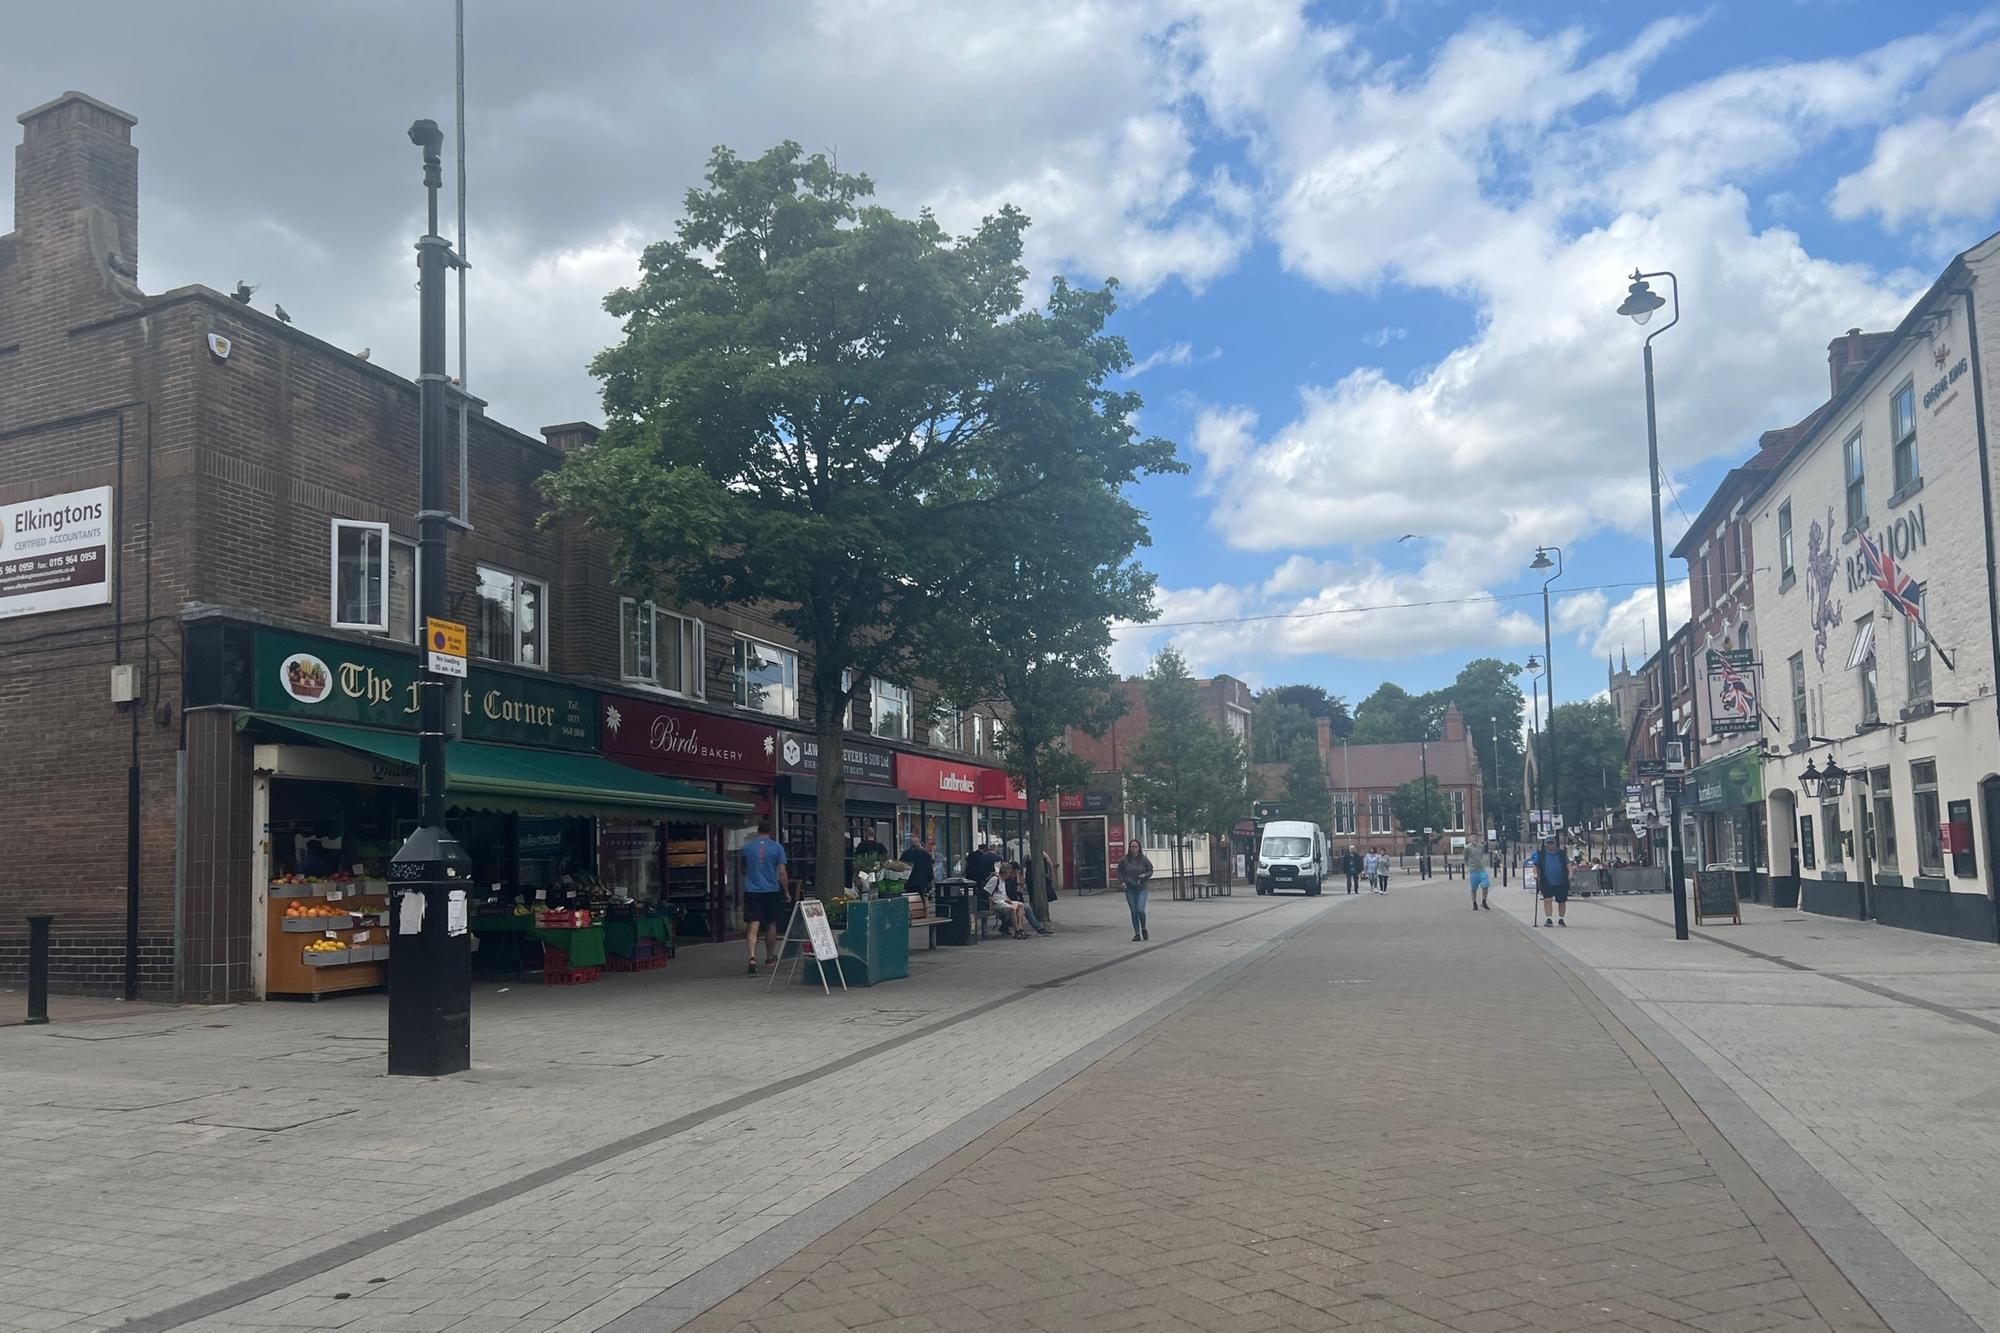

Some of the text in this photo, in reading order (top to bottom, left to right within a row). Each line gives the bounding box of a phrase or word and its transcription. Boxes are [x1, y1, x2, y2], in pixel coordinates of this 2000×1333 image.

[1923, 375, 1948, 409] GREENE
[1949, 357, 1968, 385] KING
[15, 503, 102, 533] Elkingtons
[14, 528, 101, 551] CERTIFIED ACCOUNTANTS
[49, 557, 64, 568] 0115
[65, 555, 78, 566] 964
[80, 551, 97, 563] 0958
[444, 656, 460, 666] loading
[338, 662, 393, 706] The
[483, 689, 555, 726] Corner
[650, 715, 743, 760] Birds BAKERY
[842, 749, 864, 764] EVERN
[869, 753, 880, 767] SON
[880, 755, 889, 768] Ltd
[849, 766, 864, 776] MEATS
[939, 770, 975, 793] Ladbrokes
